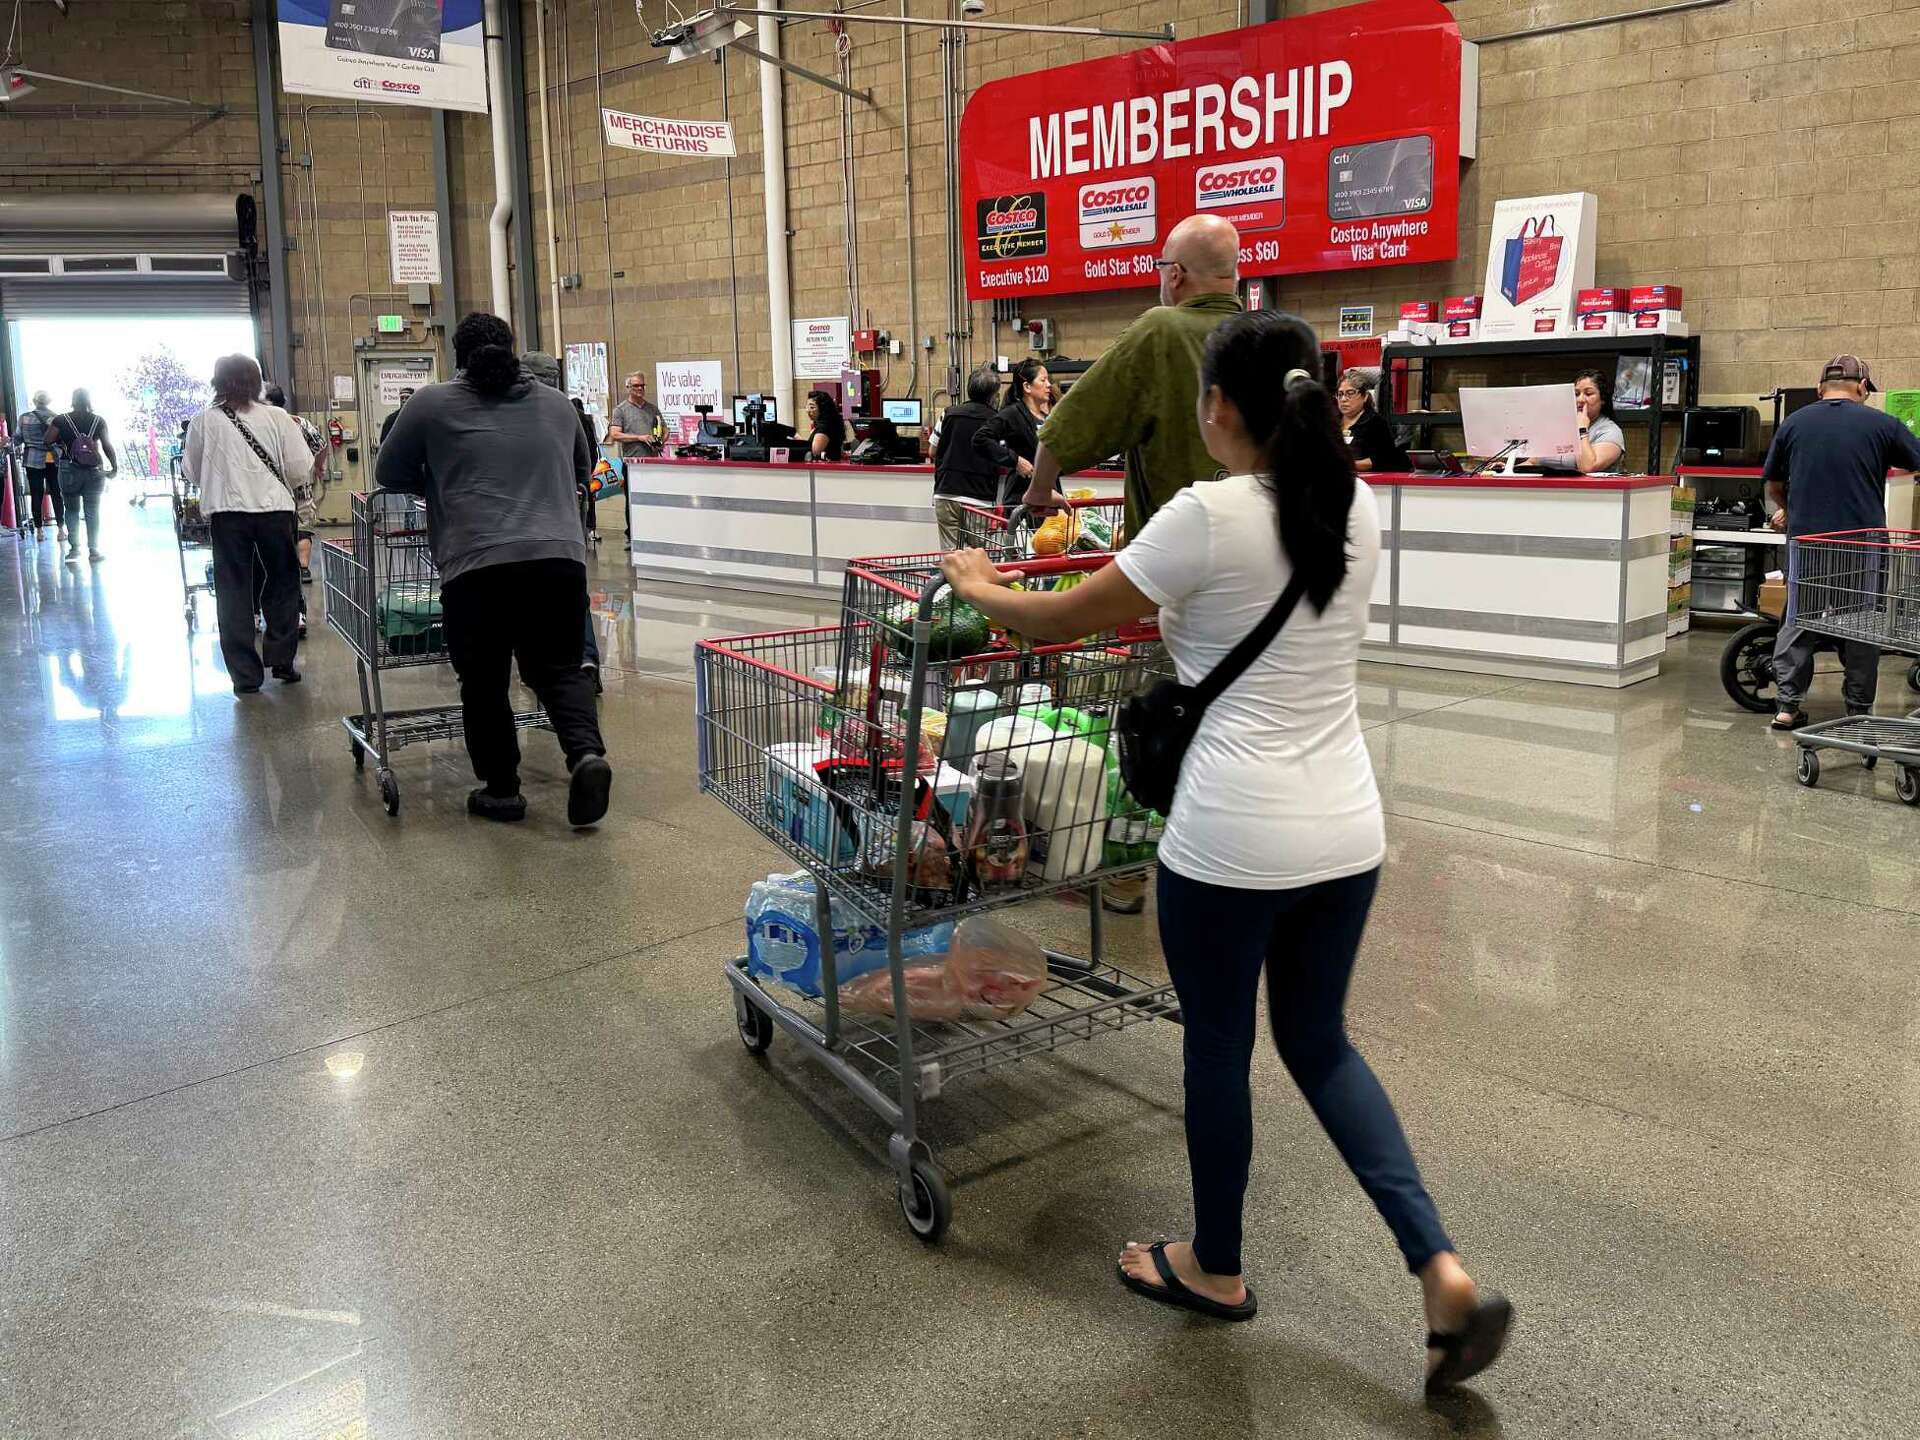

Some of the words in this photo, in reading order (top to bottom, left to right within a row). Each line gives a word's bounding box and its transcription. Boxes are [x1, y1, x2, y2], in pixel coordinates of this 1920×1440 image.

[408, 47, 435, 59] VISA
[353, 77, 371, 89] citi
[382, 80, 421, 91] COSTCO
[609, 114, 727, 139] MERCHANDISE
[1029, 59, 1353, 180] MEMBERSHIP
[632, 133, 708, 153] RETURNS
[1334, 153, 1350, 165] citi
[1199, 166, 1277, 192] COSTCO
[1082, 186, 1149, 209] COSTCO
[1223, 184, 1276, 198] WHOLESALE
[1102, 202, 1148, 214] WHOLESALE
[1403, 198, 1427, 209] VISA
[987, 209, 1037, 226] COSTCO
[1330, 226, 1369, 243] Costco
[1371, 219, 1428, 241] Anywhere
[1017, 239, 1044, 248] MEMBER
[1255, 240, 1279, 263] $60
[1380, 240, 1407, 259] Card
[1085, 258, 1107, 278] Gold
[1109, 258, 1131, 277] Star
[1133, 255, 1154, 276] $60
[980, 268, 1023, 288] Executive
[1024, 265, 1050, 286] $120
[380, 372, 413, 380] EMERGENCY
[661, 371, 676, 388] We
[679, 370, 702, 387] value
[662, 392, 681, 410] your
[683, 389, 718, 410] opinion!
